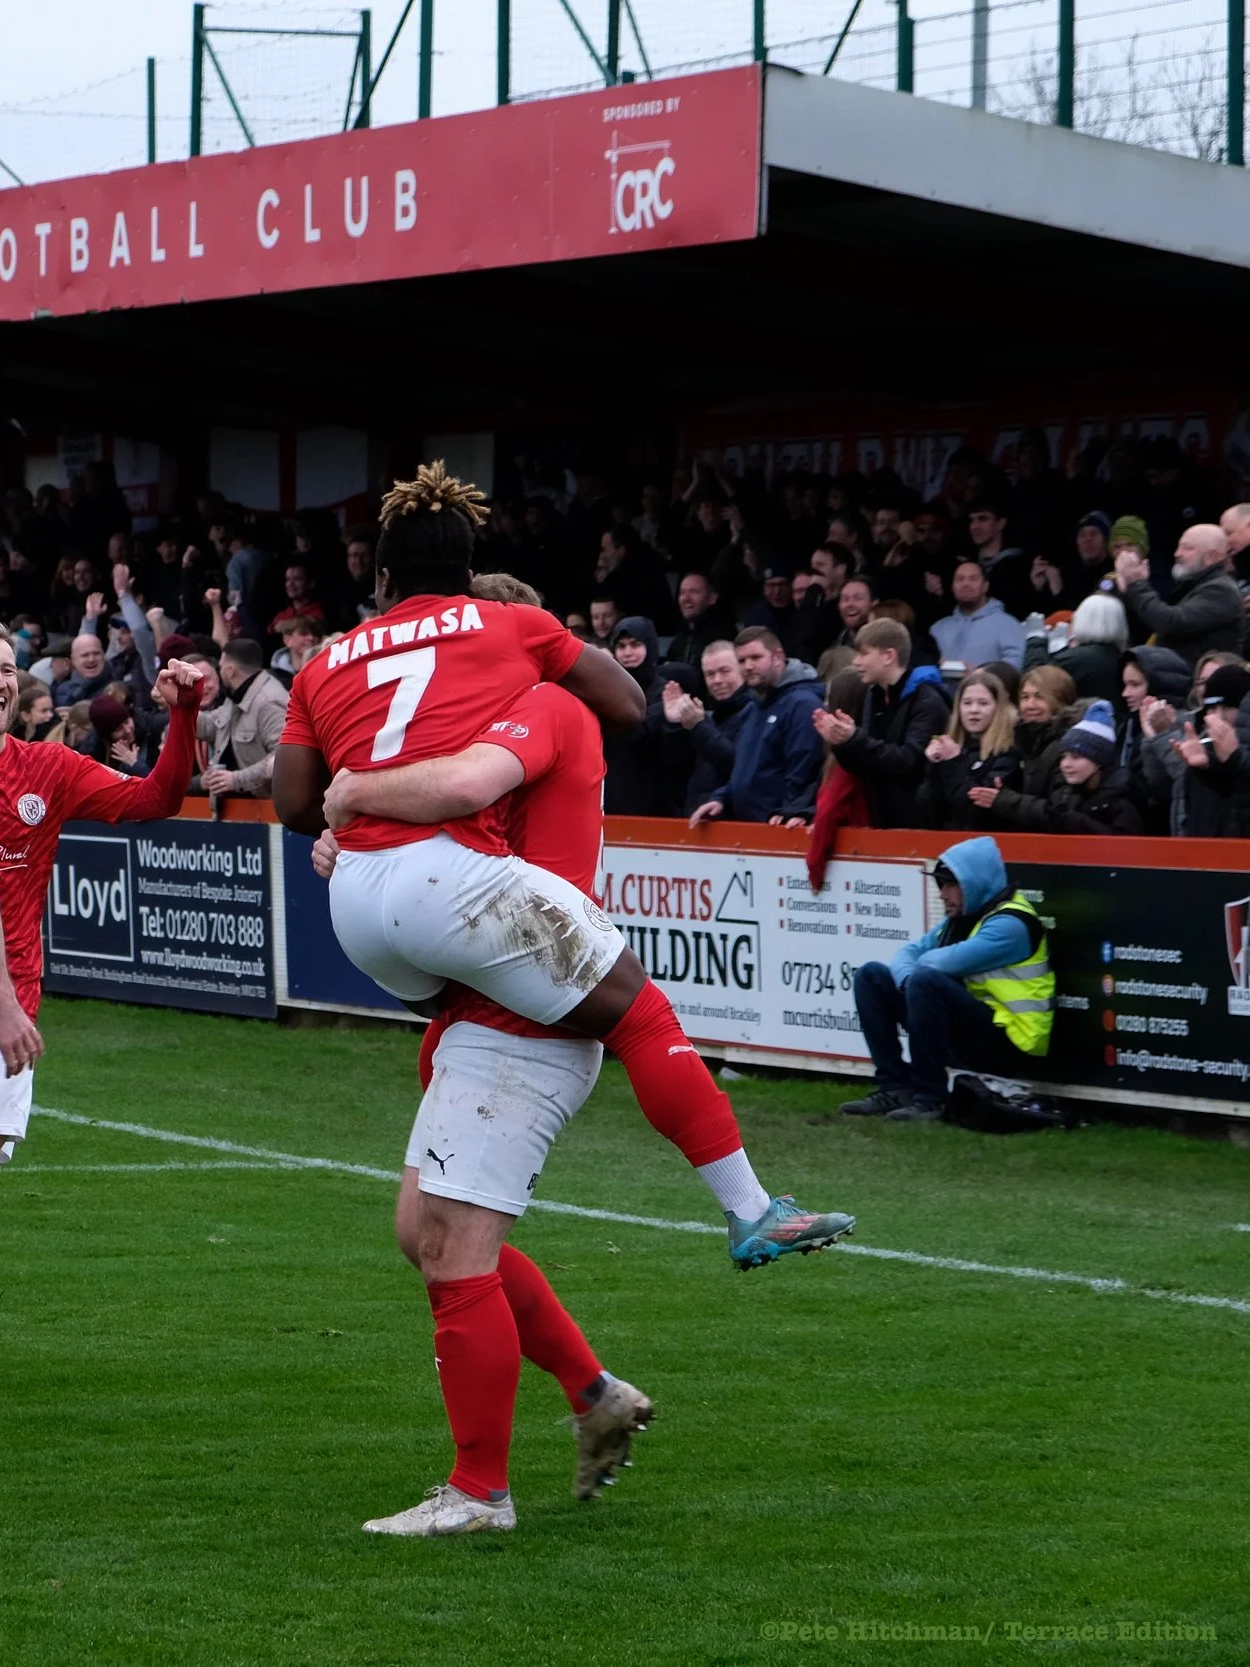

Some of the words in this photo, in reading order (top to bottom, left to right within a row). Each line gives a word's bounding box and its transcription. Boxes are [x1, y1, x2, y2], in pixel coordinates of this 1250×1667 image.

[602, 99, 664, 123] SPONSORED
[665, 96, 681, 113] BY
[257, 168, 417, 248] CLUB
[616, 157, 676, 232] CRC
[327, 603, 484, 670] MATWASA
[366, 645, 437, 763] 7
[136, 838, 233, 877] Woodworking
[237, 845, 263, 876] Ltd
[53, 863, 127, 927] Lloyd
[192, 882, 202, 899] of
[202, 882, 233, 903] Bespoke
[233, 885, 263, 907] Joinery
[854, 879, 902, 897] Alterations
[786, 896, 838, 914] Conversions
[855, 902, 872, 917] New
[874, 902, 902, 918] Builds
[139, 906, 164, 938] Tel:
[165, 908, 207, 942] 01280
[209, 913, 236, 945] 703
[237, 916, 265, 948] 888
[787, 917, 839, 936] Renovations
[855, 922, 911, 941] Maintenance
[614, 924, 755, 990] UILDING
[782, 961, 835, 996] 07734
[688, 1002, 701, 1015] and
[783, 1007, 863, 1033] mcurtisbuild
